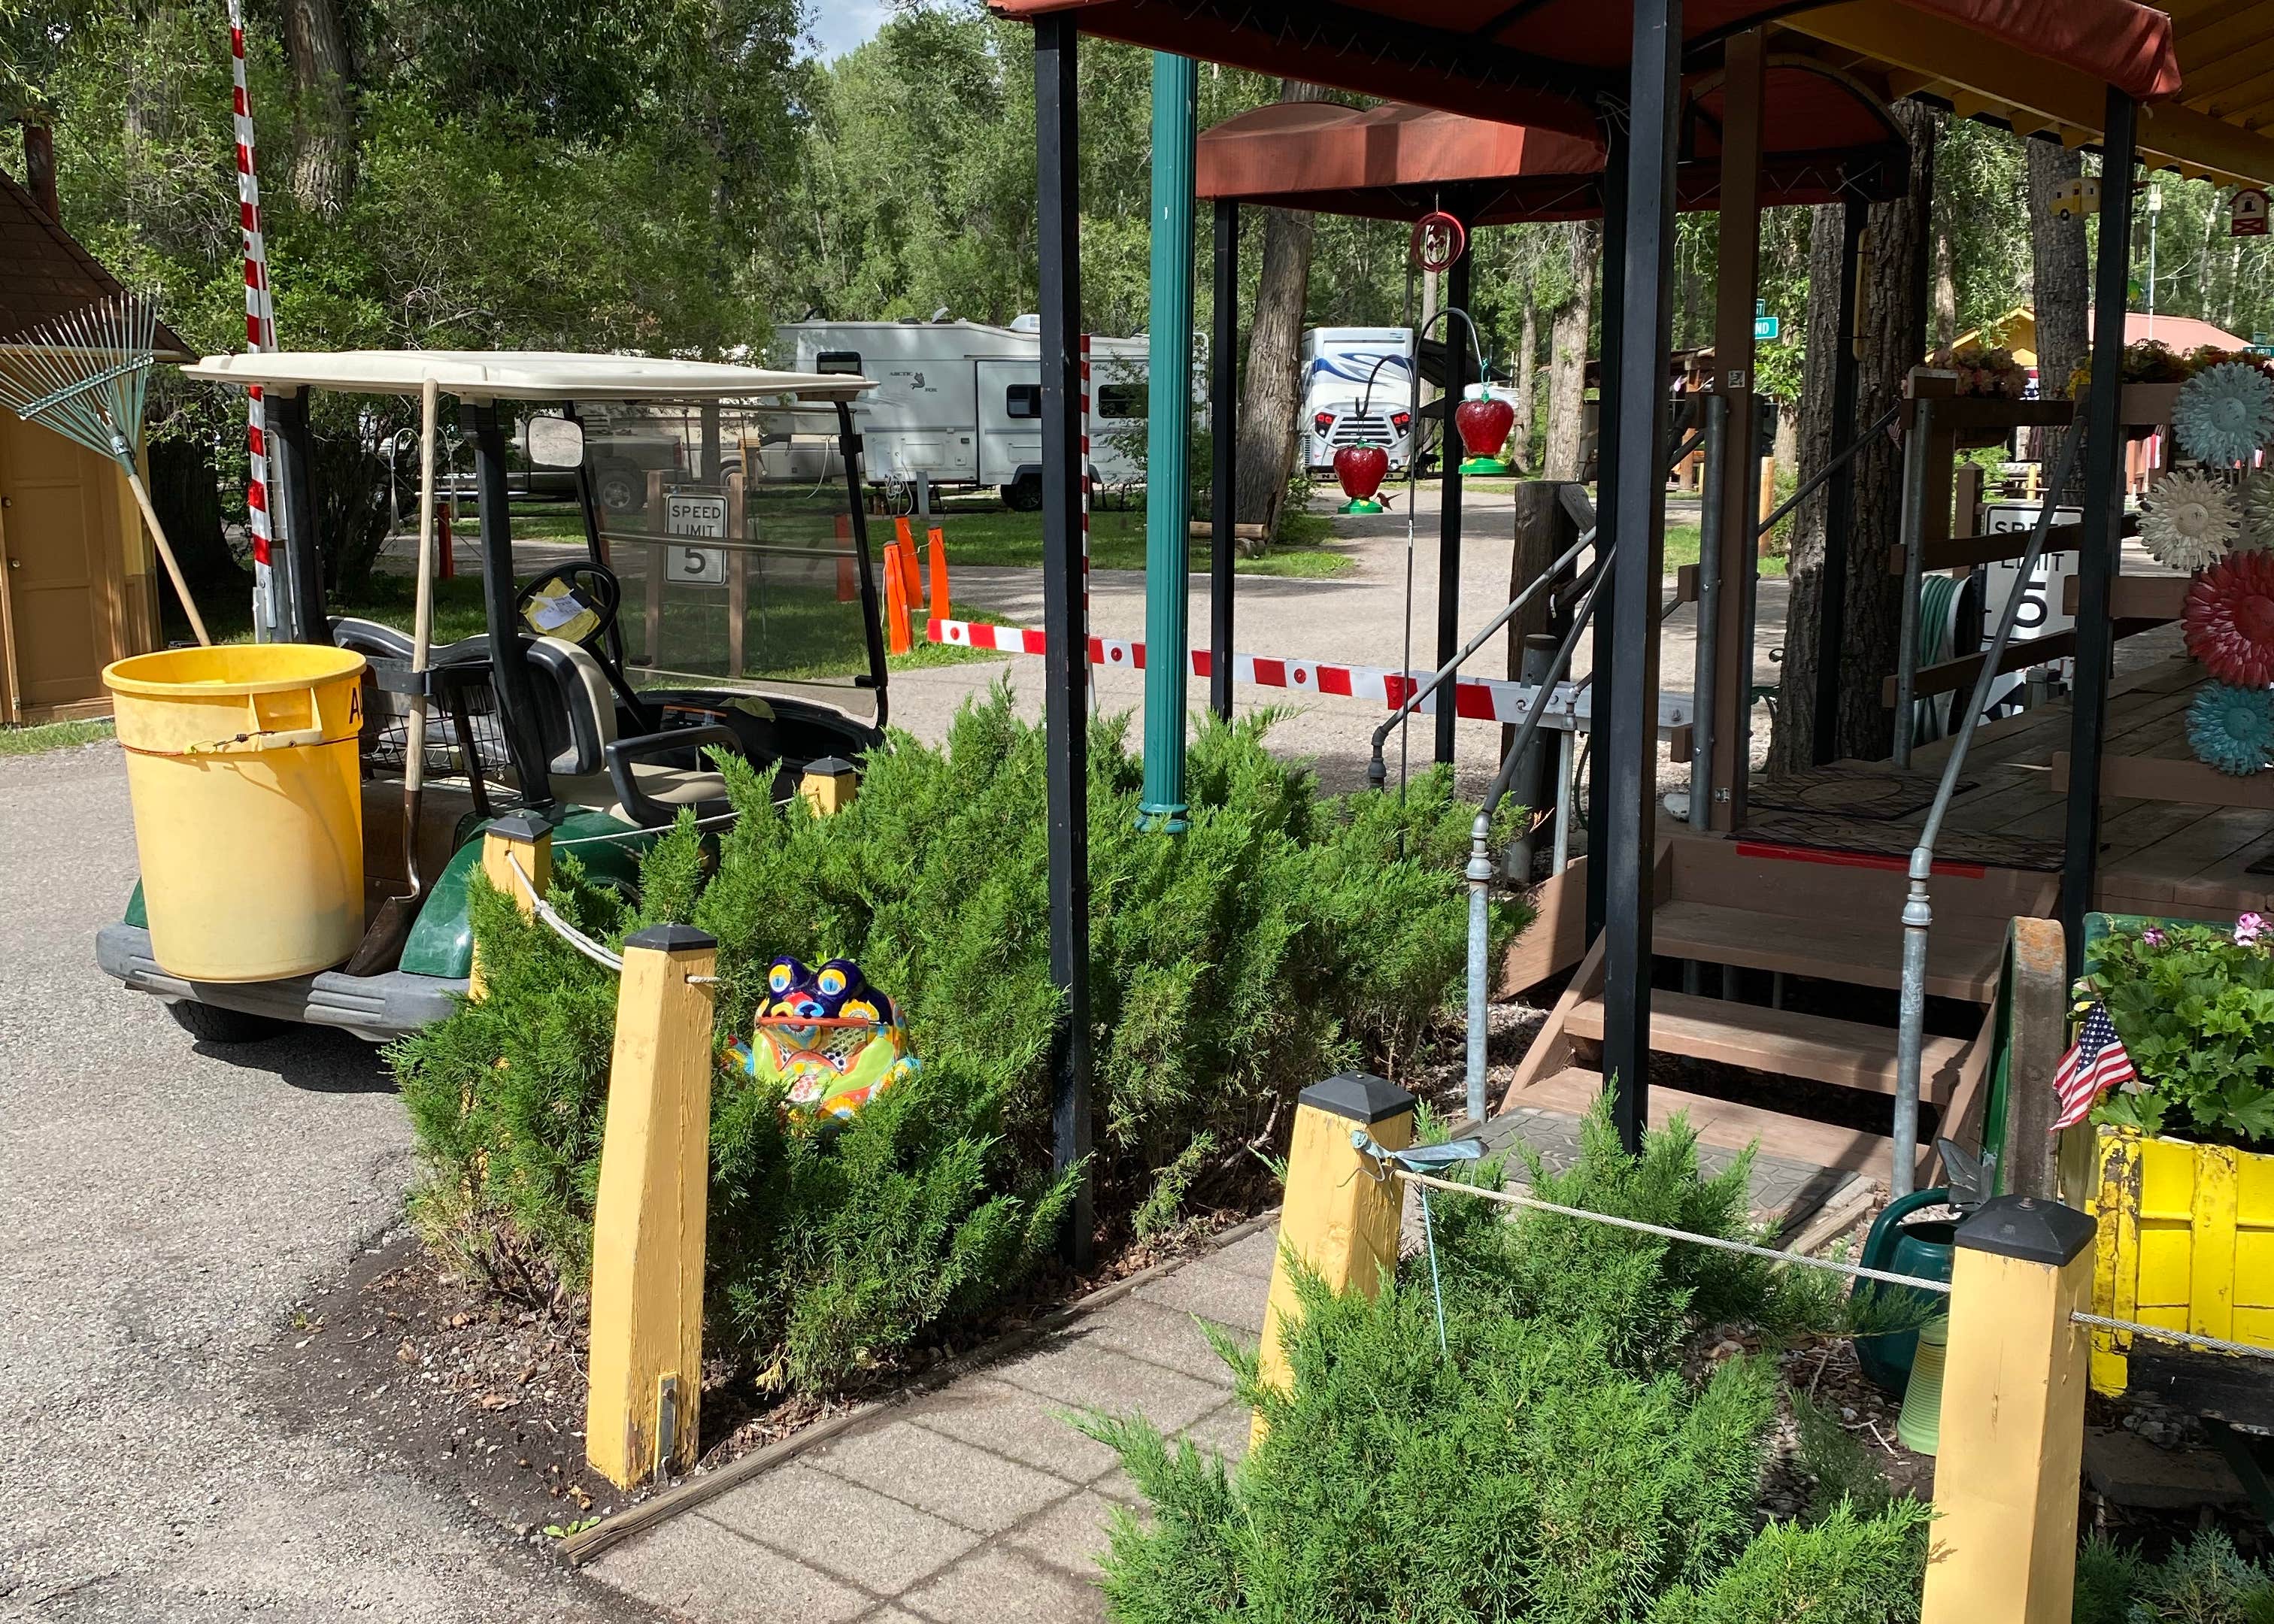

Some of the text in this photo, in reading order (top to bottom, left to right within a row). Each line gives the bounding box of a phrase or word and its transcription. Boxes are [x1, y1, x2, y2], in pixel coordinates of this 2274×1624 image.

[1754, 322, 1769, 335] ND
[672, 505, 721, 519] SPEED
[684, 547, 706, 574] 5
[2013, 581, 2048, 628] 5
